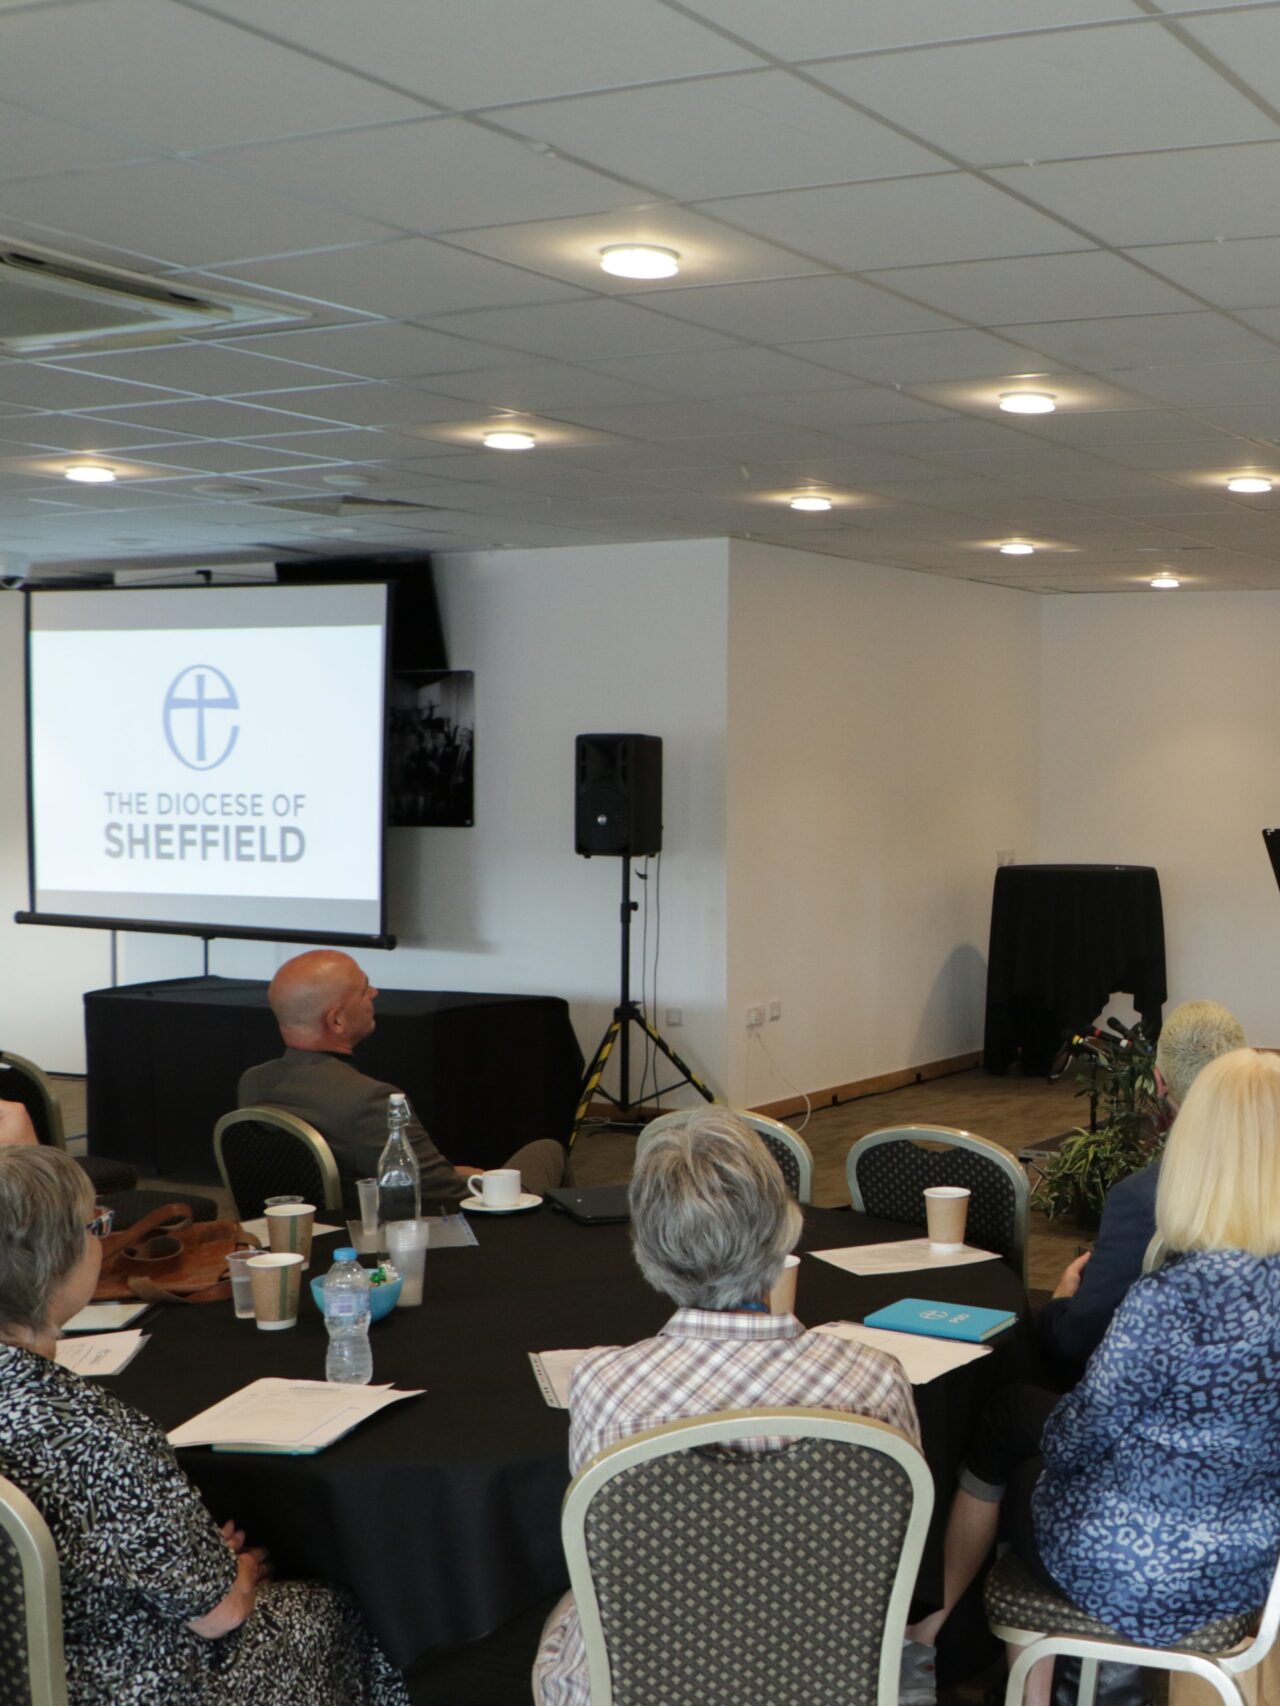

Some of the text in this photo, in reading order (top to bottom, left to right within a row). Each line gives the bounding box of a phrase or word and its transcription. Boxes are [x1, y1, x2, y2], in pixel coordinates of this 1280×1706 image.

[104, 791, 306, 817] THE DIOCESE OF
[104, 821, 306, 863] SHEFFIELD
